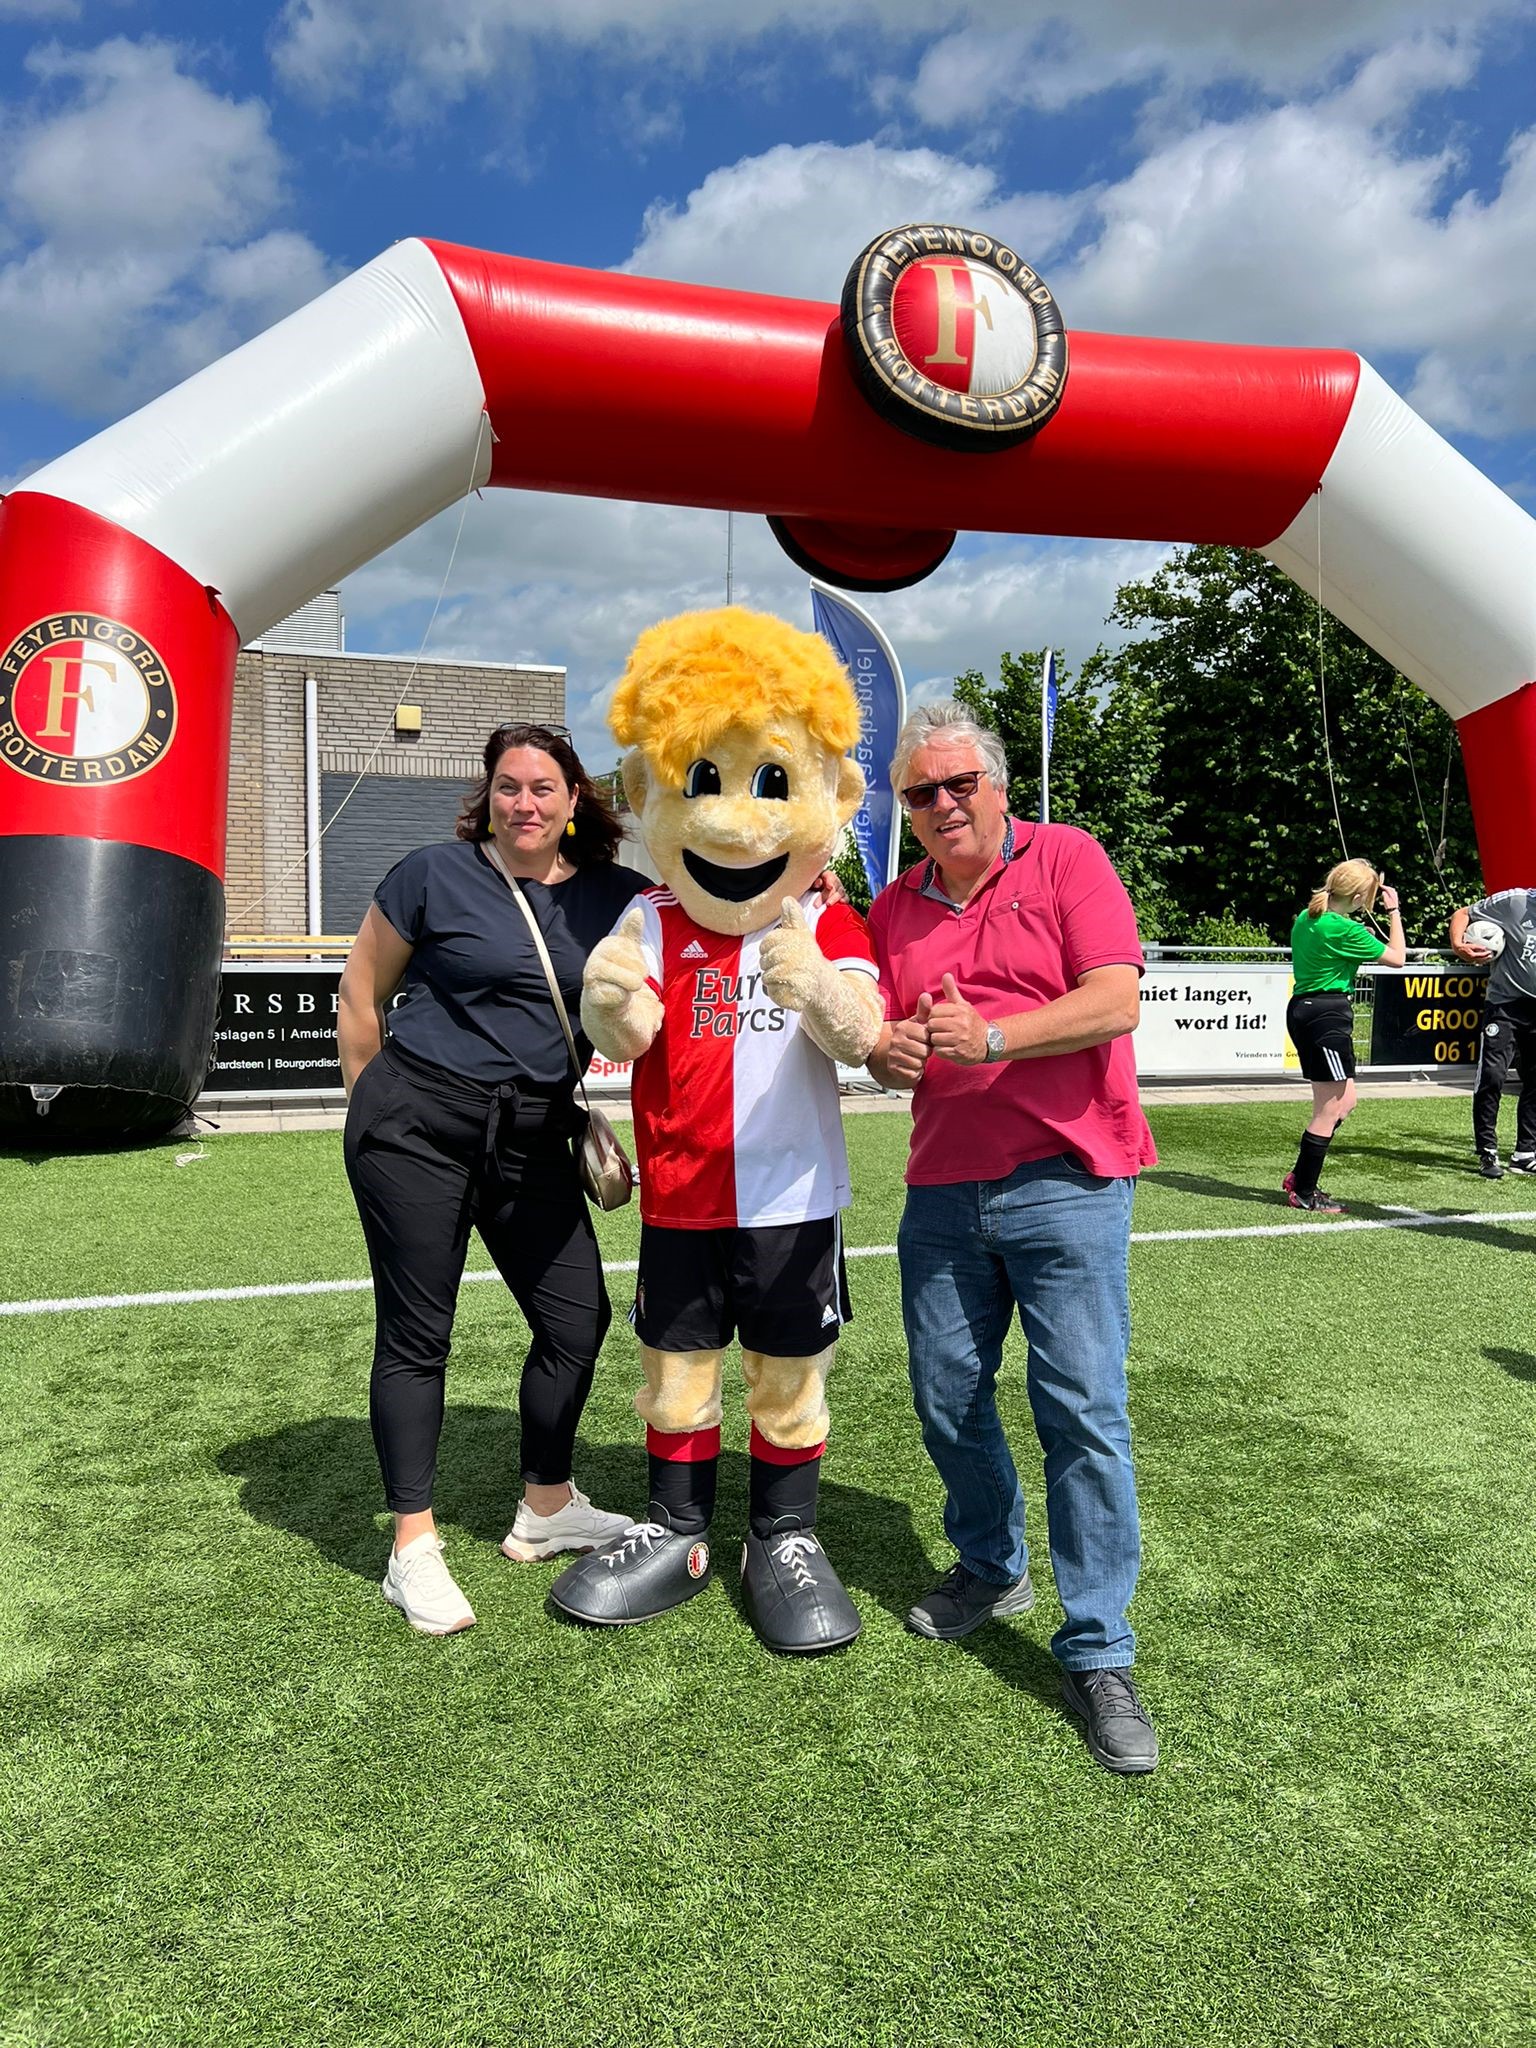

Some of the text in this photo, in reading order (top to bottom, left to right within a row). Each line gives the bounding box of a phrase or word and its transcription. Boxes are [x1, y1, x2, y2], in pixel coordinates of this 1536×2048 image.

[872, 226, 1053, 304] FEYENOORD
[920, 263, 1009, 365] F
[874, 337, 1060, 420] ROTTERDAM
[3, 618, 166, 687] FEYENOORD
[35, 656, 118, 737] F
[0, 721, 163, 780] ROTTERDAM
[691, 968, 772, 1004] Eur
[1140, 986, 1252, 1005] niet langer,
[267, 1029, 275, 1039] 5
[290, 1027, 338, 1039] Ameide
[690, 1006, 785, 1037] Parcs
[1175, 1014, 1267, 1030] word lid!
[1416, 1009, 1484, 1030] GROO
[1434, 1041, 1460, 1062] 06
